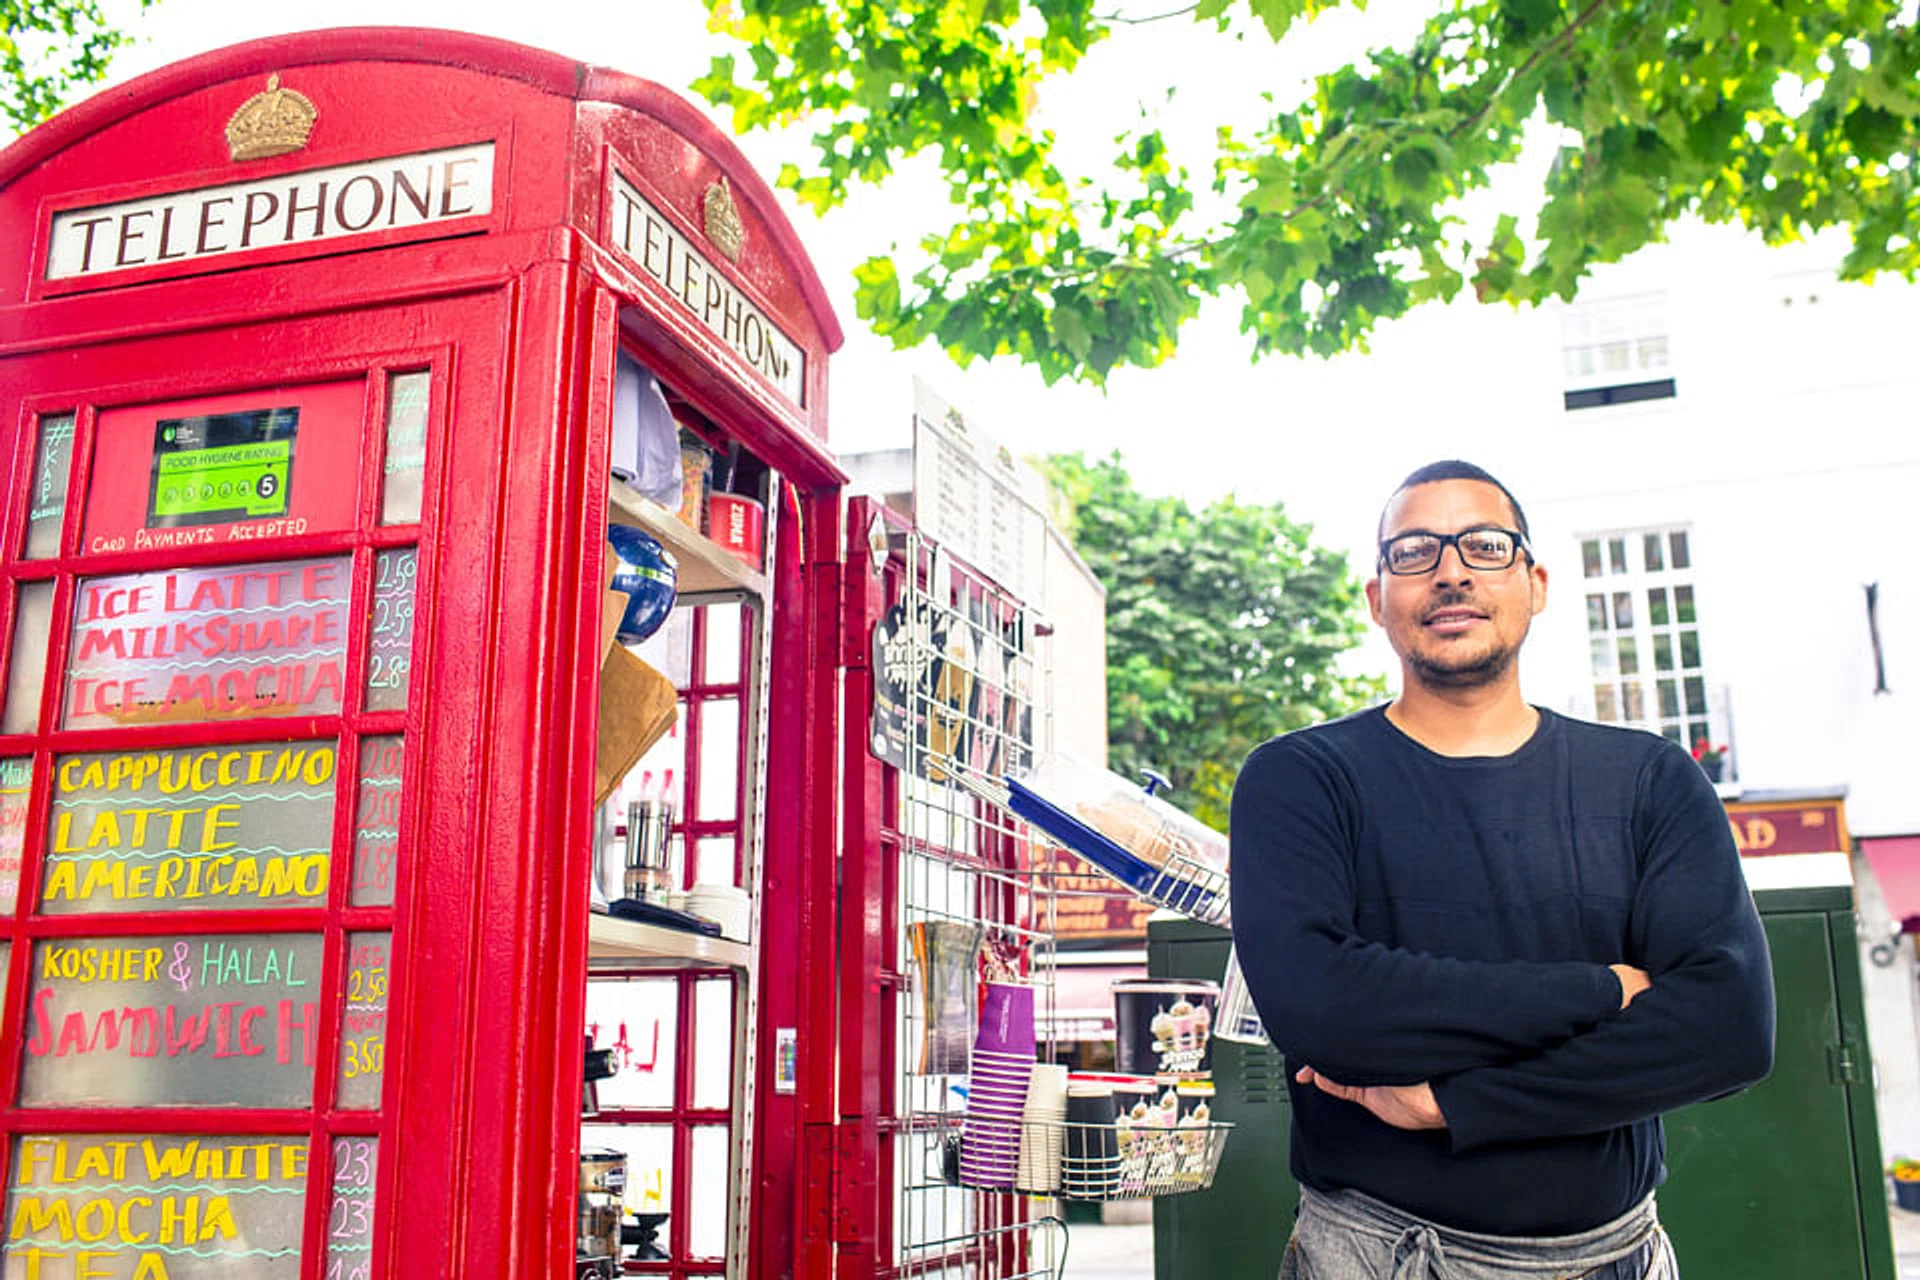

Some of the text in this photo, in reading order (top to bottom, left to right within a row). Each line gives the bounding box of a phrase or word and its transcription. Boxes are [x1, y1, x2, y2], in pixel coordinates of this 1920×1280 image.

[72, 158, 478, 273] TELEPHONE
[619, 189, 791, 380] TELEPHON
[166, 449, 284, 468] FOOD HYGIENE RATING
[261, 476, 274, 495] 5
[92, 517, 308, 553] CARD PAYMENTS ACCEPTED
[80, 563, 336, 623] ICE LATTE
[377, 554, 417, 592] 2.50
[78, 610, 338, 661] MILKSHAKE
[70, 661, 344, 719] ICE MOCHA
[59, 747, 334, 794] CAPPUCCINO
[54, 804, 241, 853] LATTE
[43, 854, 330, 901] AMERICANO
[43, 941, 306, 992] KOSHER & HALAL
[351, 945, 384, 967] VEG
[27, 986, 316, 1067] SANDWICH
[19, 1138, 307, 1185] FLAT WHITE
[9, 1195, 239, 1245] MOCHA
[8, 1247, 171, 1280] TEA
